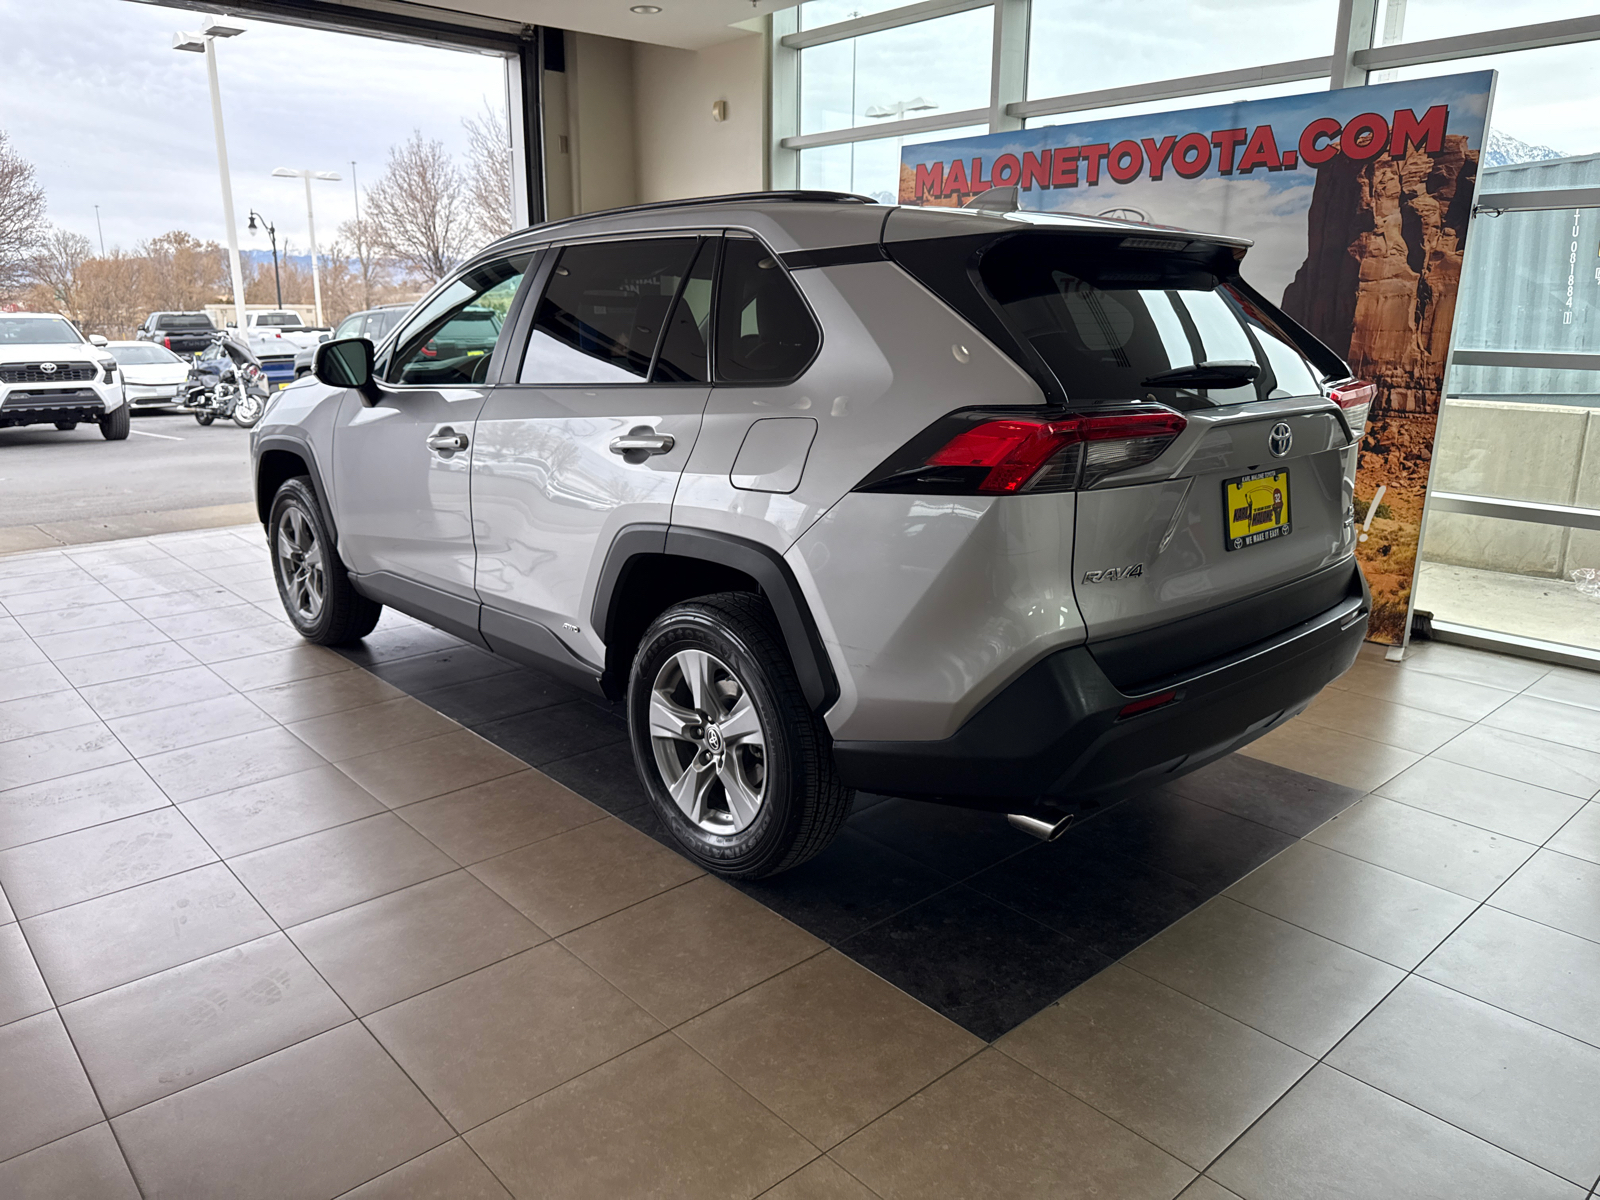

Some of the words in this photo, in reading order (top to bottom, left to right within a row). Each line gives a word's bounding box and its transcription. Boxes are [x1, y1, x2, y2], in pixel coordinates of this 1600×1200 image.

[914, 104, 1450, 199] MALONETOYOTA.COM
[1274, 493, 1281, 503] 32
[1245, 536, 1252, 545] WE
[1253, 532, 1265, 543] MAKE
[1264, 531, 1269, 540] IT
[1269, 528, 1280, 539] EASY
[1081, 562, 1144, 585] RAV4
